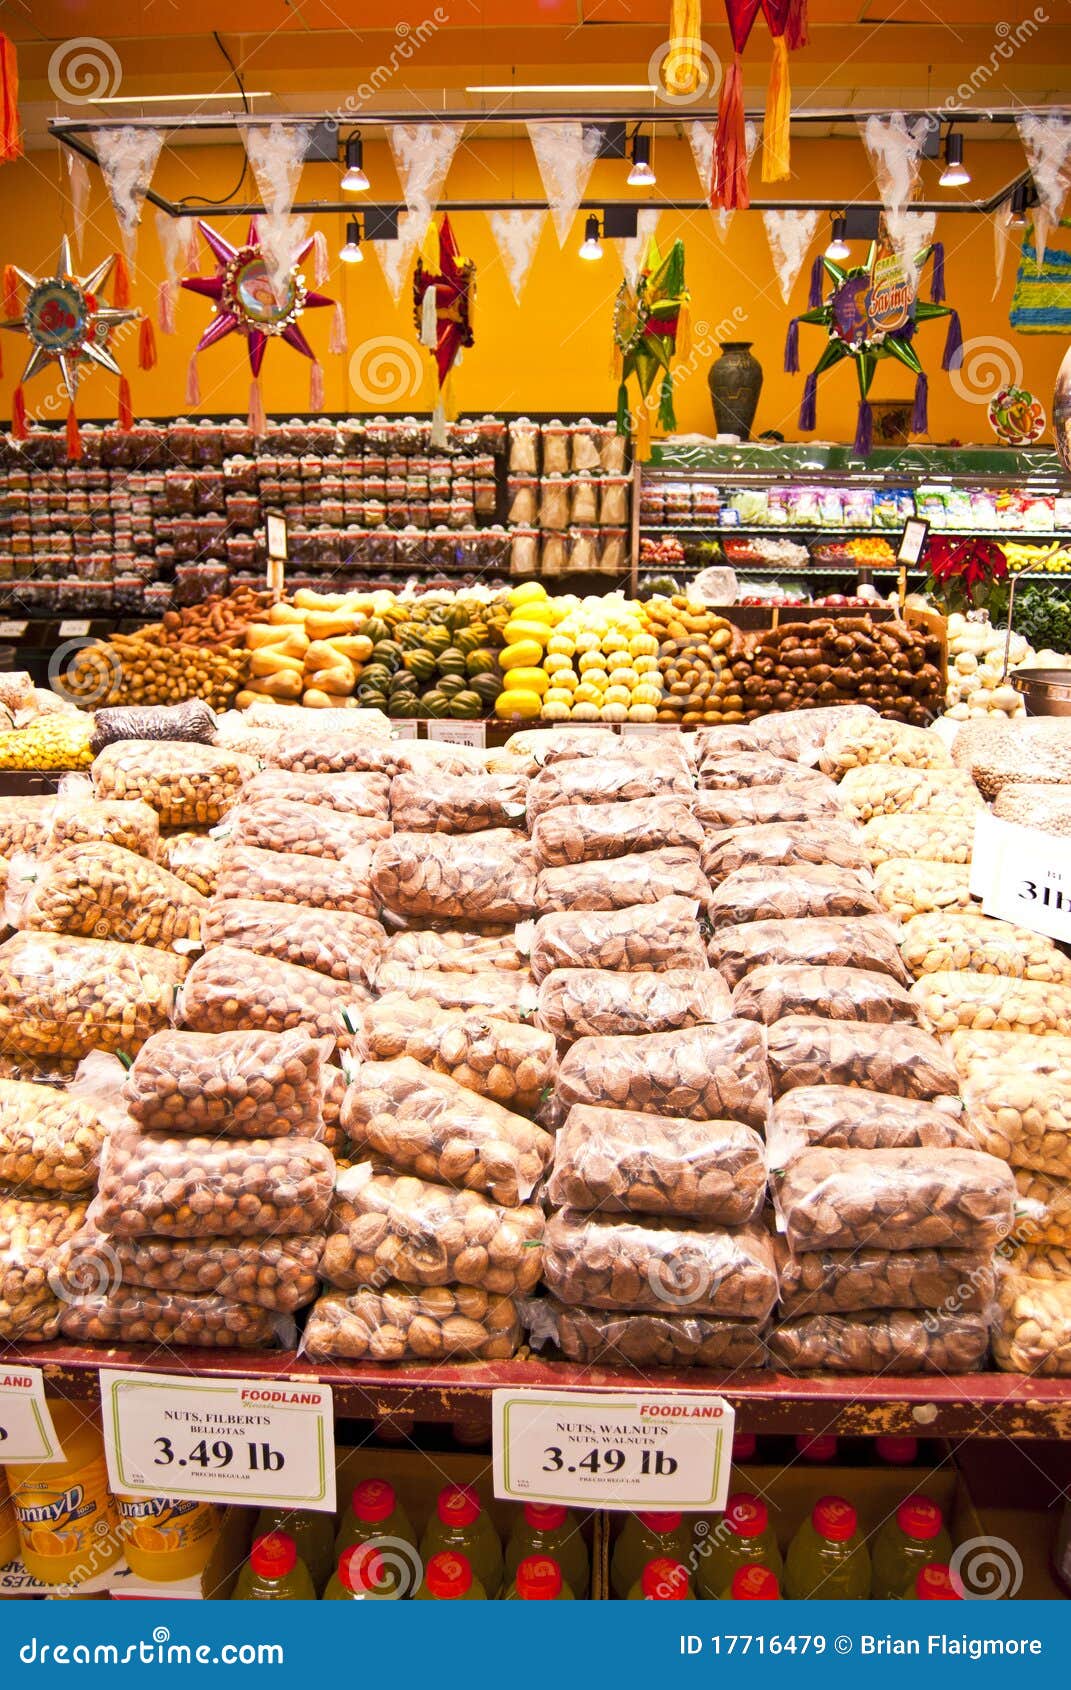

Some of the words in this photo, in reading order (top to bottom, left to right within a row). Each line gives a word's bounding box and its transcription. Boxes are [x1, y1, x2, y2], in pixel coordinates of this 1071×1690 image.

[868, 280, 915, 322] Savings
[0, 1376, 32, 1388] AND
[241, 1390, 322, 1405] FOODLAND
[164, 1410, 203, 1424] NUTS,
[206, 1413, 271, 1426] FILBERTS
[640, 1405, 724, 1418] FOODLAND
[190, 1426, 246, 1436] BELLOTAS
[556, 1423, 596, 1434] NUTS,
[600, 1425, 669, 1436] WALNUTS
[568, 1435, 599, 1445] NUTS,
[602, 1437, 656, 1446] WALNUTS
[154, 1437, 234, 1469] 3.49
[248, 1442, 285, 1472] lb
[542, 1447, 626, 1473] 3.49
[640, 1450, 678, 1476] lb
[17, 1485, 84, 1521] unnyD
